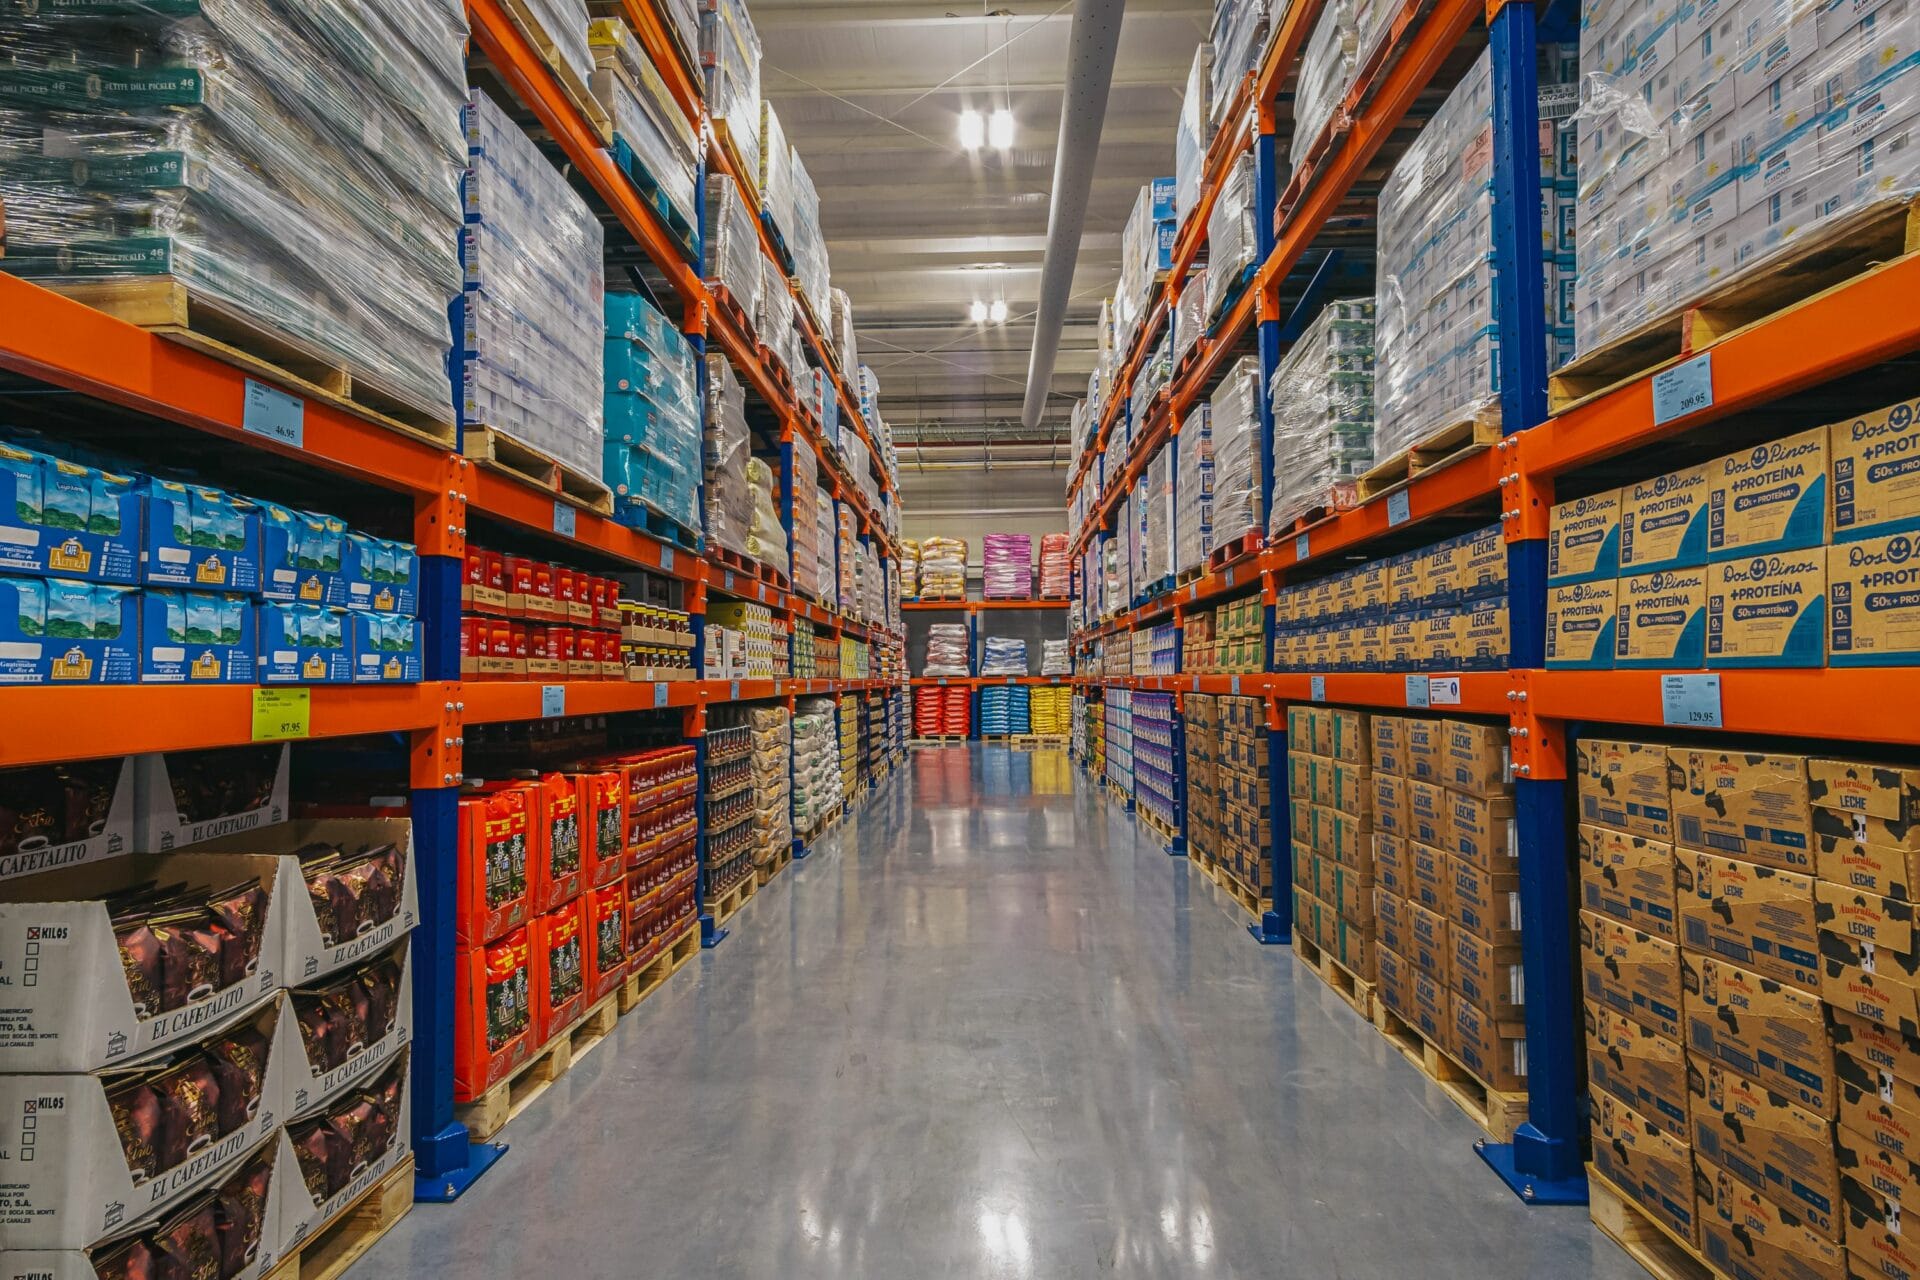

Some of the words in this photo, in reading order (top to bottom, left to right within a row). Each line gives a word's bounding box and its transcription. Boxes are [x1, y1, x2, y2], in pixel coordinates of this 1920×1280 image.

[148, 82, 176, 90] PICKLES
[180, 78, 194, 87] 46
[162, 161, 178, 169] 46
[150, 248, 164, 257] 46
[1680, 392, 1705, 410] 209.95
[275, 426, 294, 438] 46.95
[1852, 420, 1889, 442] Dos
[1724, 458, 1752, 476] Dos
[1768, 443, 1820, 464] Pinos
[1731, 464, 1805, 492] +PROTEÍNA
[1874, 465, 1894, 479] 50%
[1634, 485, 1654, 500] Dos
[1667, 474, 1705, 492] Pinos
[1559, 506, 1576, 520] Dos
[1586, 497, 1616, 513] Pinos
[1639, 494, 1694, 516] +PROTEÍNA
[1738, 498, 1752, 508] 50%
[1563, 514, 1608, 534] +PROTEÍNA
[1472, 538, 1496, 556] LECHE
[1432, 551, 1452, 567] LECHE
[1849, 546, 1887, 568] Dos
[1397, 562, 1414, 578] LECHE
[1723, 565, 1750, 582] Dos
[1766, 557, 1818, 577] Pinos
[1630, 578, 1650, 594] Dos
[1663, 572, 1702, 592] Pinos
[1730, 580, 1803, 600] +PROTEÍNA
[1557, 589, 1574, 602] Dos
[1584, 585, 1612, 600] Pinos
[1635, 594, 1690, 610] +PROTEÍNA
[1872, 596, 1892, 608] 50%
[1561, 603, 1604, 617] +PROTEÍNA
[1737, 608, 1751, 617] 50%
[1430, 618, 1450, 632] LECHE
[1472, 611, 1496, 628] LECHE
[1393, 623, 1410, 636] LECHE
[1688, 712, 1714, 722] 129.95
[280, 722, 300, 732] 87.95
[1377, 728, 1393, 740] LECHE
[1411, 731, 1429, 745] LECHE
[1452, 732, 1472, 750] LECHE
[1716, 777, 1735, 788] LECHE
[1832, 779, 1872, 792] Australian
[1378, 786, 1394, 800] LECHE
[1414, 794, 1432, 810] LECHE
[1840, 795, 1866, 810] LECHE
[1454, 804, 1476, 822] LECHE
[192, 827, 206, 842] EL
[206, 812, 259, 839] CAFETALITO
[0, 844, 86, 876] CAFETALITO
[1416, 856, 1434, 873] LECHE
[1842, 854, 1882, 870] Australian
[1456, 872, 1478, 894] LECHE
[1850, 872, 1876, 889] LECHE
[1724, 884, 1744, 898] LECHE
[1840, 904, 1881, 922] Australian
[41, 927, 68, 939] KILOS
[1414, 918, 1432, 938] LECHE
[1848, 922, 1875, 939] LECHE
[334, 950, 345, 964] EL
[1458, 940, 1478, 966] LECHE
[1416, 978, 1435, 1003] LECHE
[1848, 982, 1890, 1004] Australian
[1729, 992, 1749, 1010] LECHE
[152, 1020, 170, 1040] EL
[172, 987, 244, 1034] CAFETALITO
[1856, 1001, 1884, 1020] LECHE
[1458, 1008, 1479, 1036] LECHE
[1616, 1036, 1630, 1050] LECHE
[1858, 1028, 1901, 1052] Australian
[324, 1073, 337, 1090] EL
[338, 1042, 386, 1086] CAFETALITO
[1866, 1047, 1895, 1069] LECHE
[38, 1098, 64, 1110] KILOS
[1736, 1102, 1756, 1121] LECHE
[1865, 1110, 1910, 1138] Australian
[1621, 1129, 1636, 1146] LECHE
[1874, 1130, 1904, 1154] LECHE
[152, 1183, 167, 1201] EL
[170, 1132, 245, 1193] CAFETALITO
[1864, 1155, 1908, 1184] Australian
[323, 1204, 335, 1220] EL
[335, 1160, 385, 1211] CAFETALITO
[1872, 1174, 1901, 1201] LECHE
[1744, 1214, 1767, 1236] LECHE
[1872, 1236, 1916, 1270] Australian
[1881, 1258, 1910, 1280] LECHE
